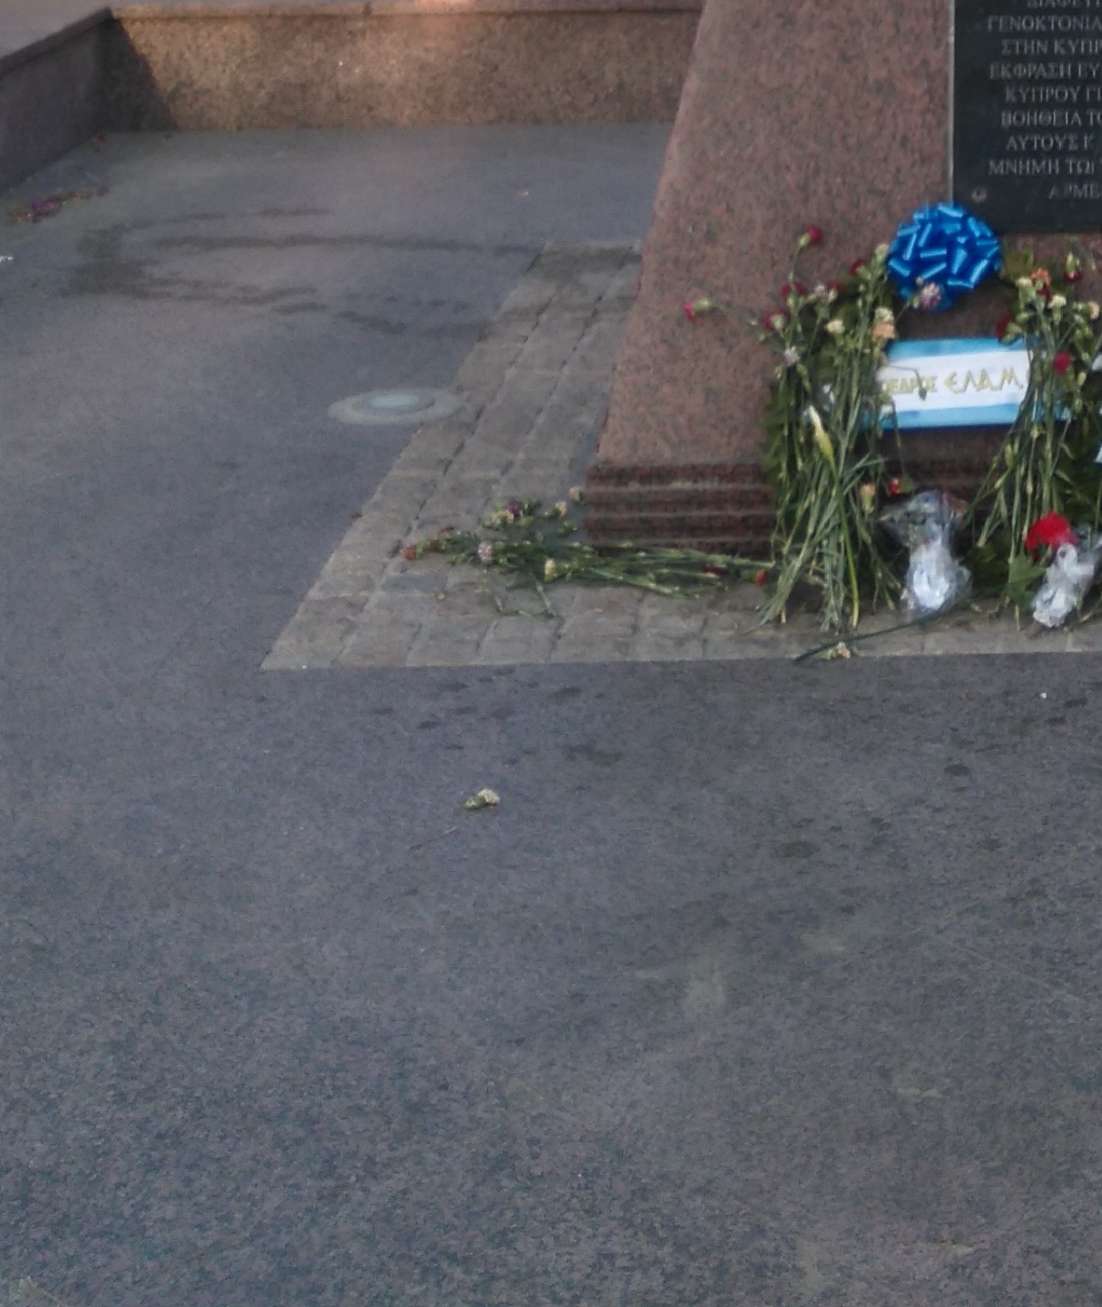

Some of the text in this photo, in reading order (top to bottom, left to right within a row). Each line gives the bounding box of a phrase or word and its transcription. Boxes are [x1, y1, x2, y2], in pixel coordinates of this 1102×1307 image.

[1001, 38, 1048, 56] ΣΤΗΝ
[989, 62, 1072, 80] ΕΚΦΡΑΣΗ
[1005, 85, 1080, 103] ΚΥΠΡΟΥ
[1000, 109, 1082, 127] ΒΟΗΘΕΙΑ
[1006, 134, 1079, 151] ΑΥΤΟΥΣ
[988, 158, 1060, 176] ΜΝΗΜΗ
